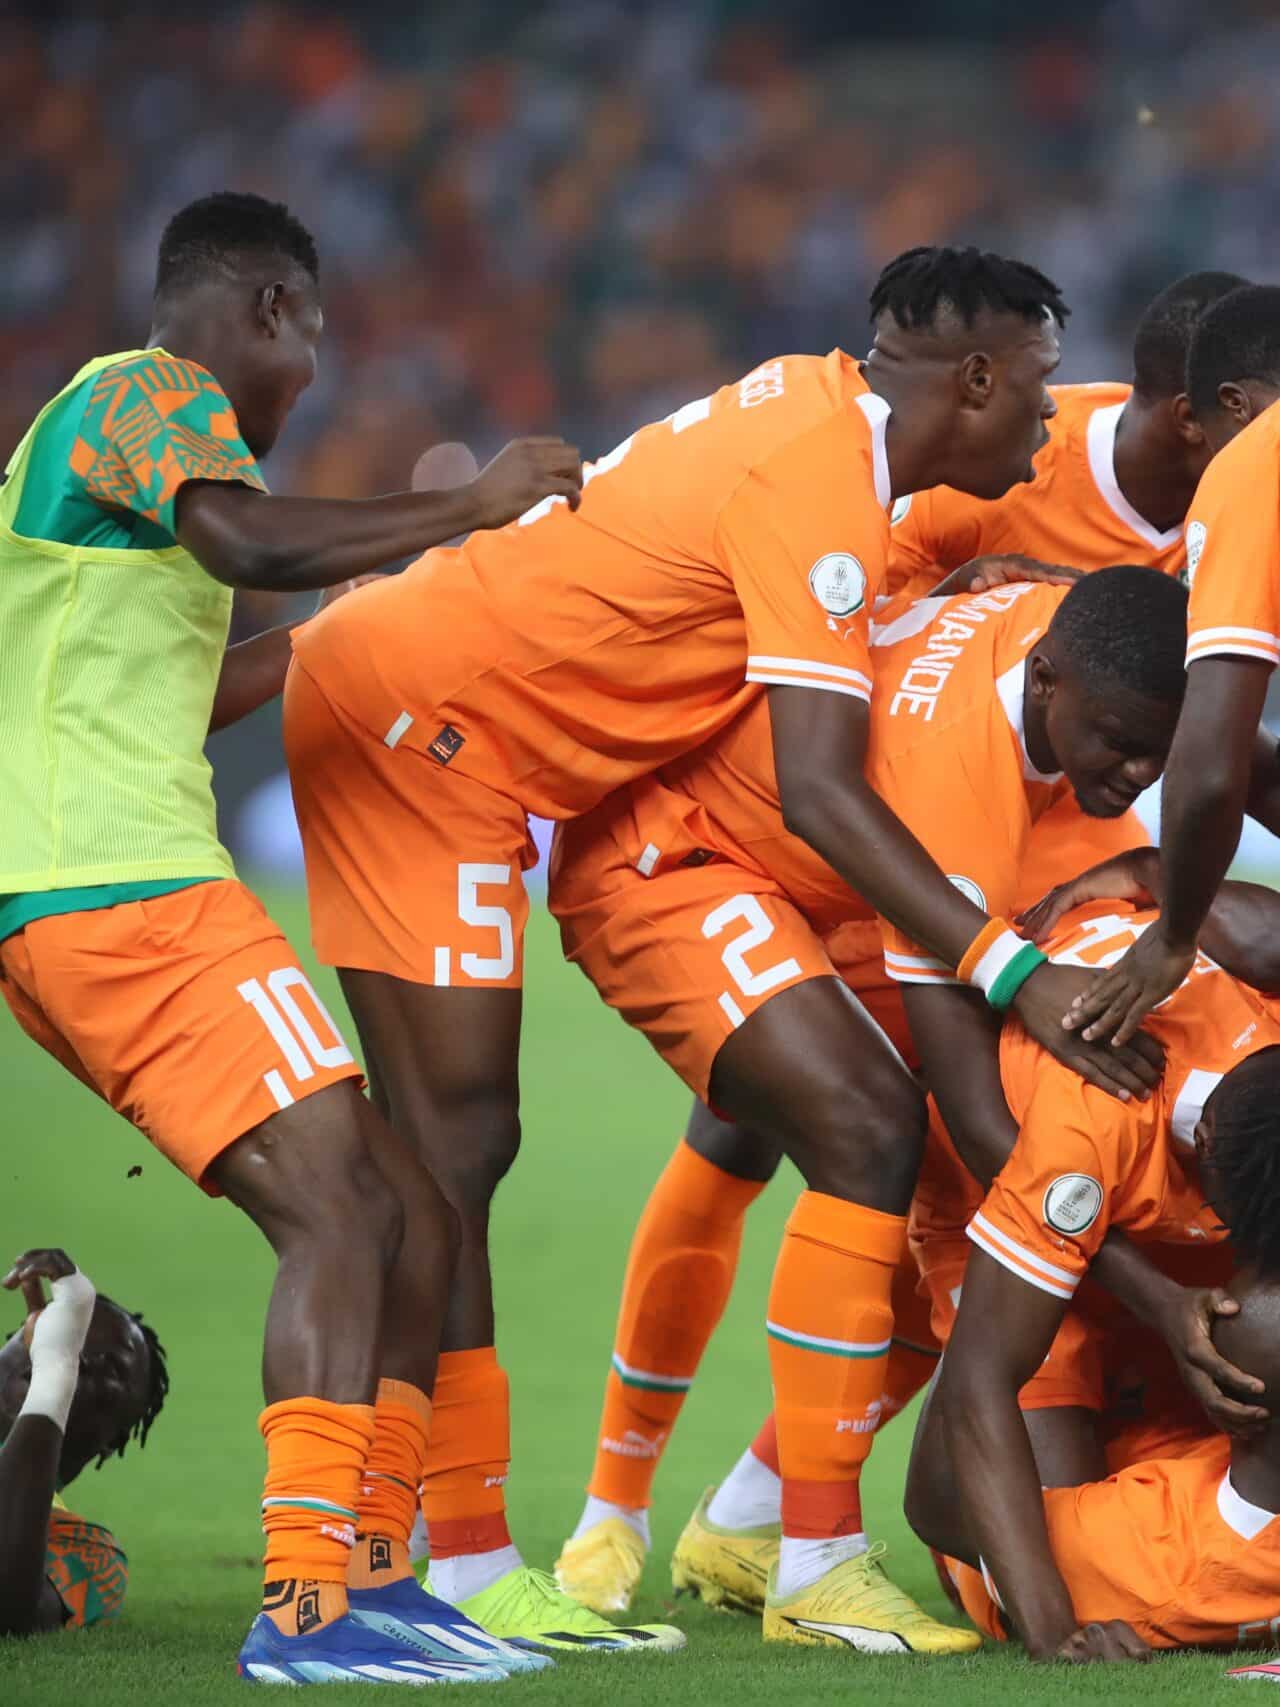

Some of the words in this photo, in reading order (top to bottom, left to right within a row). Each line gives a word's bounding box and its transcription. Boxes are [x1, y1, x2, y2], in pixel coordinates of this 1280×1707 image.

[457, 862, 515, 980] 5
[701, 893, 804, 997] 2
[235, 966, 355, 1083] 10
